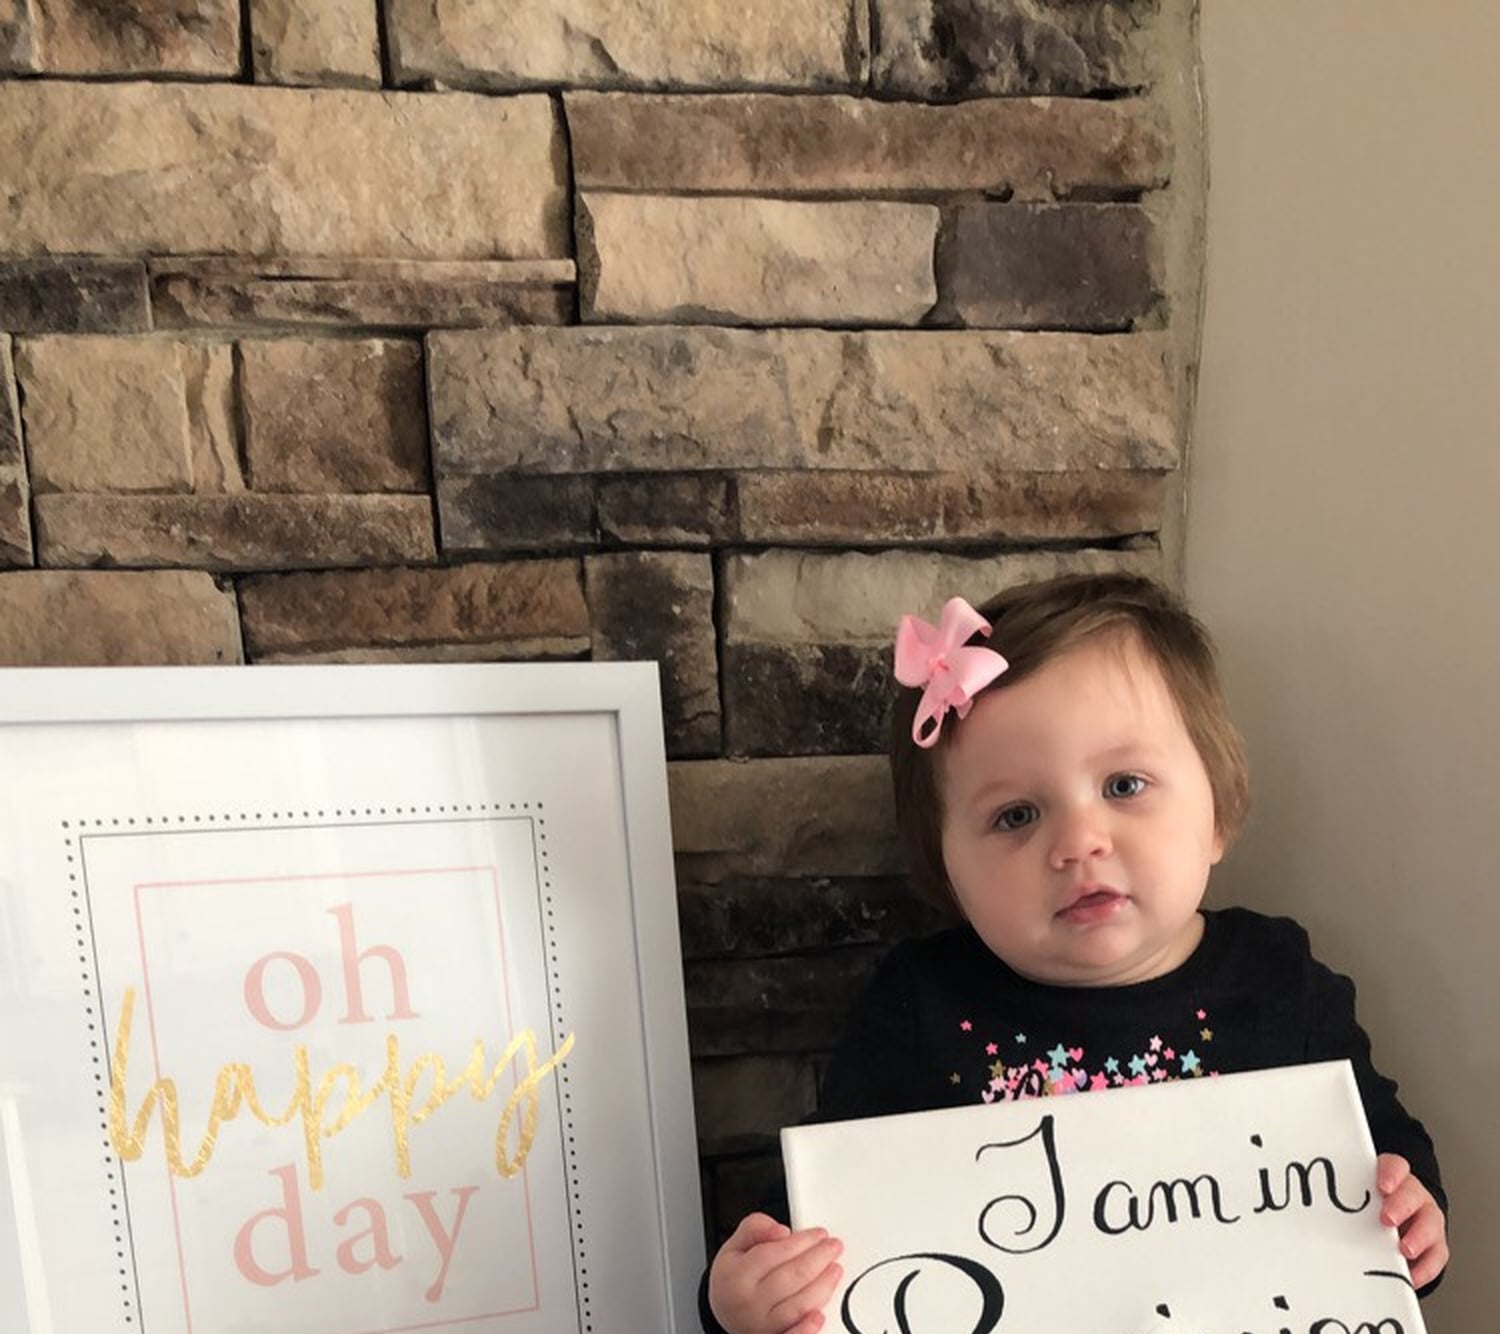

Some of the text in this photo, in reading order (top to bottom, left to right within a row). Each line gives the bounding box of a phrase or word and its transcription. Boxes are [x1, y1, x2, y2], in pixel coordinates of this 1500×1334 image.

[243, 901, 421, 1032] oh
[108, 985, 576, 1191] happy
[232, 1164, 481, 1304] day
[1093, 1173, 1241, 1235] am
[1251, 1133, 1372, 1213] in
